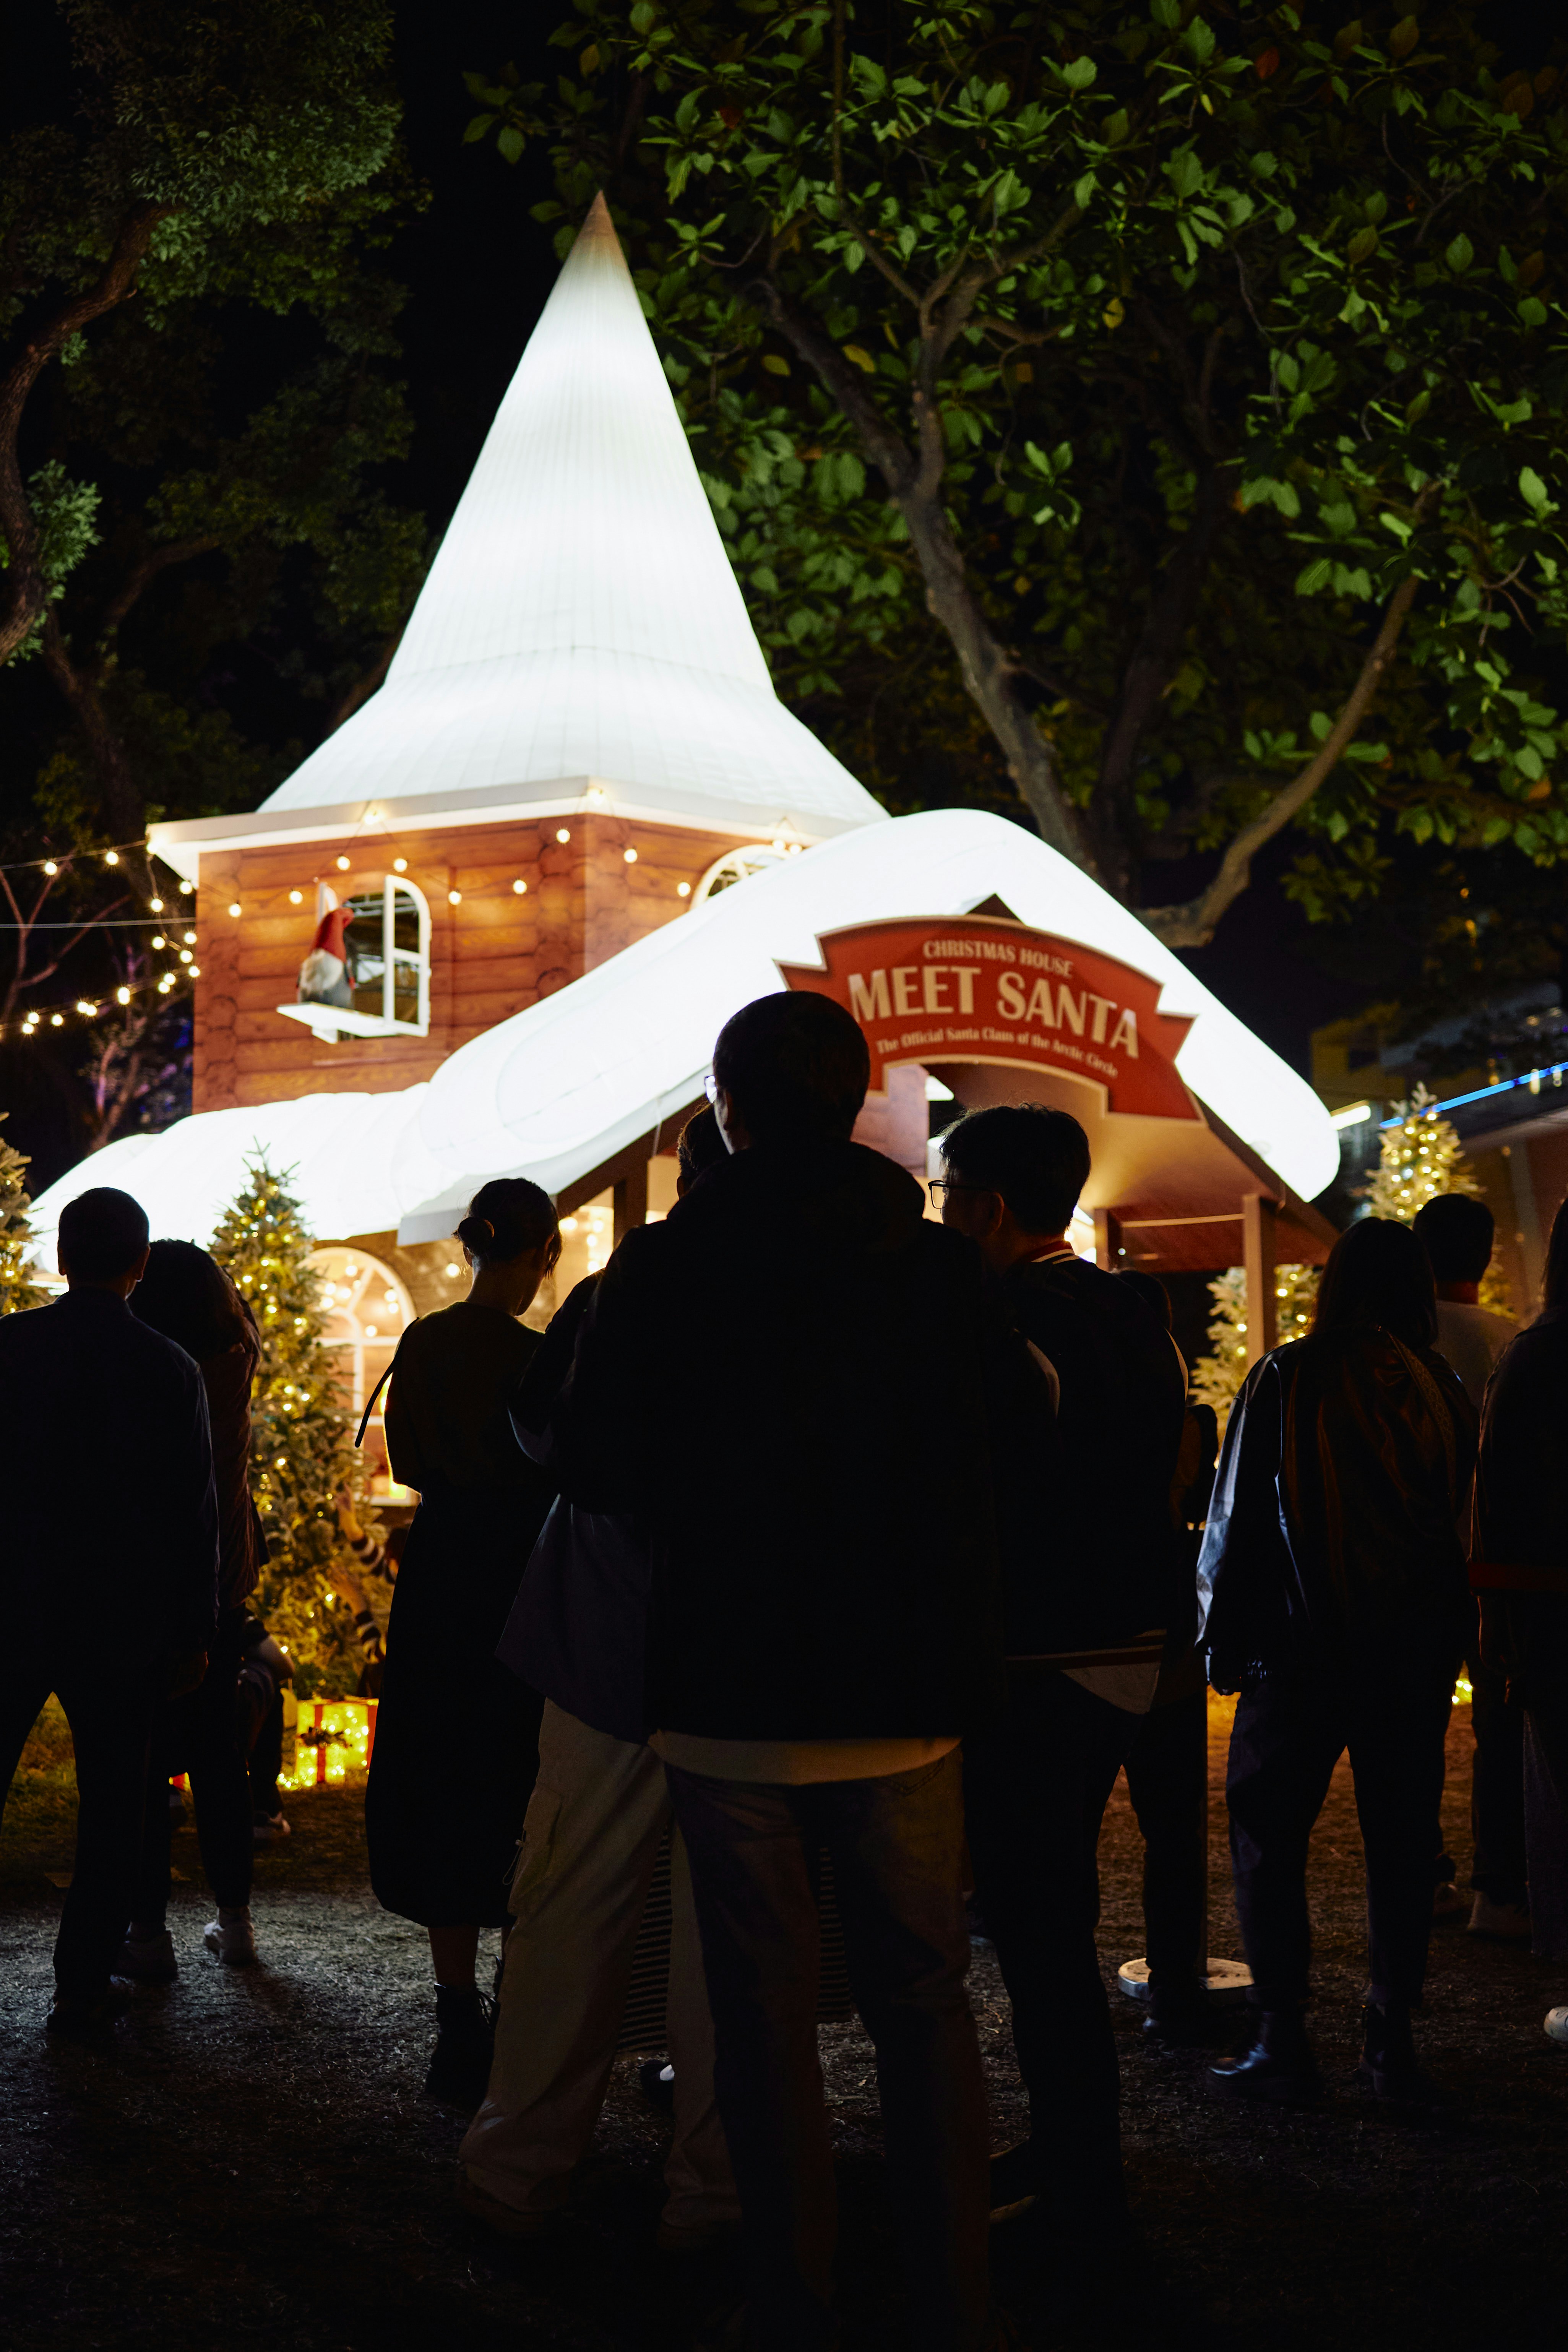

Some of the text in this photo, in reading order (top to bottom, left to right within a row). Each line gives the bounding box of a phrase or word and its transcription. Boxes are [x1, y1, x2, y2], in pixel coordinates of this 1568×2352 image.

[923, 940, 1073, 979] CHRISTMAS HOUSE
[848, 966, 1139, 1058] MEET SANTA
[877, 1027, 1118, 1078] The Official Santa Claus of the Arctic Circle
